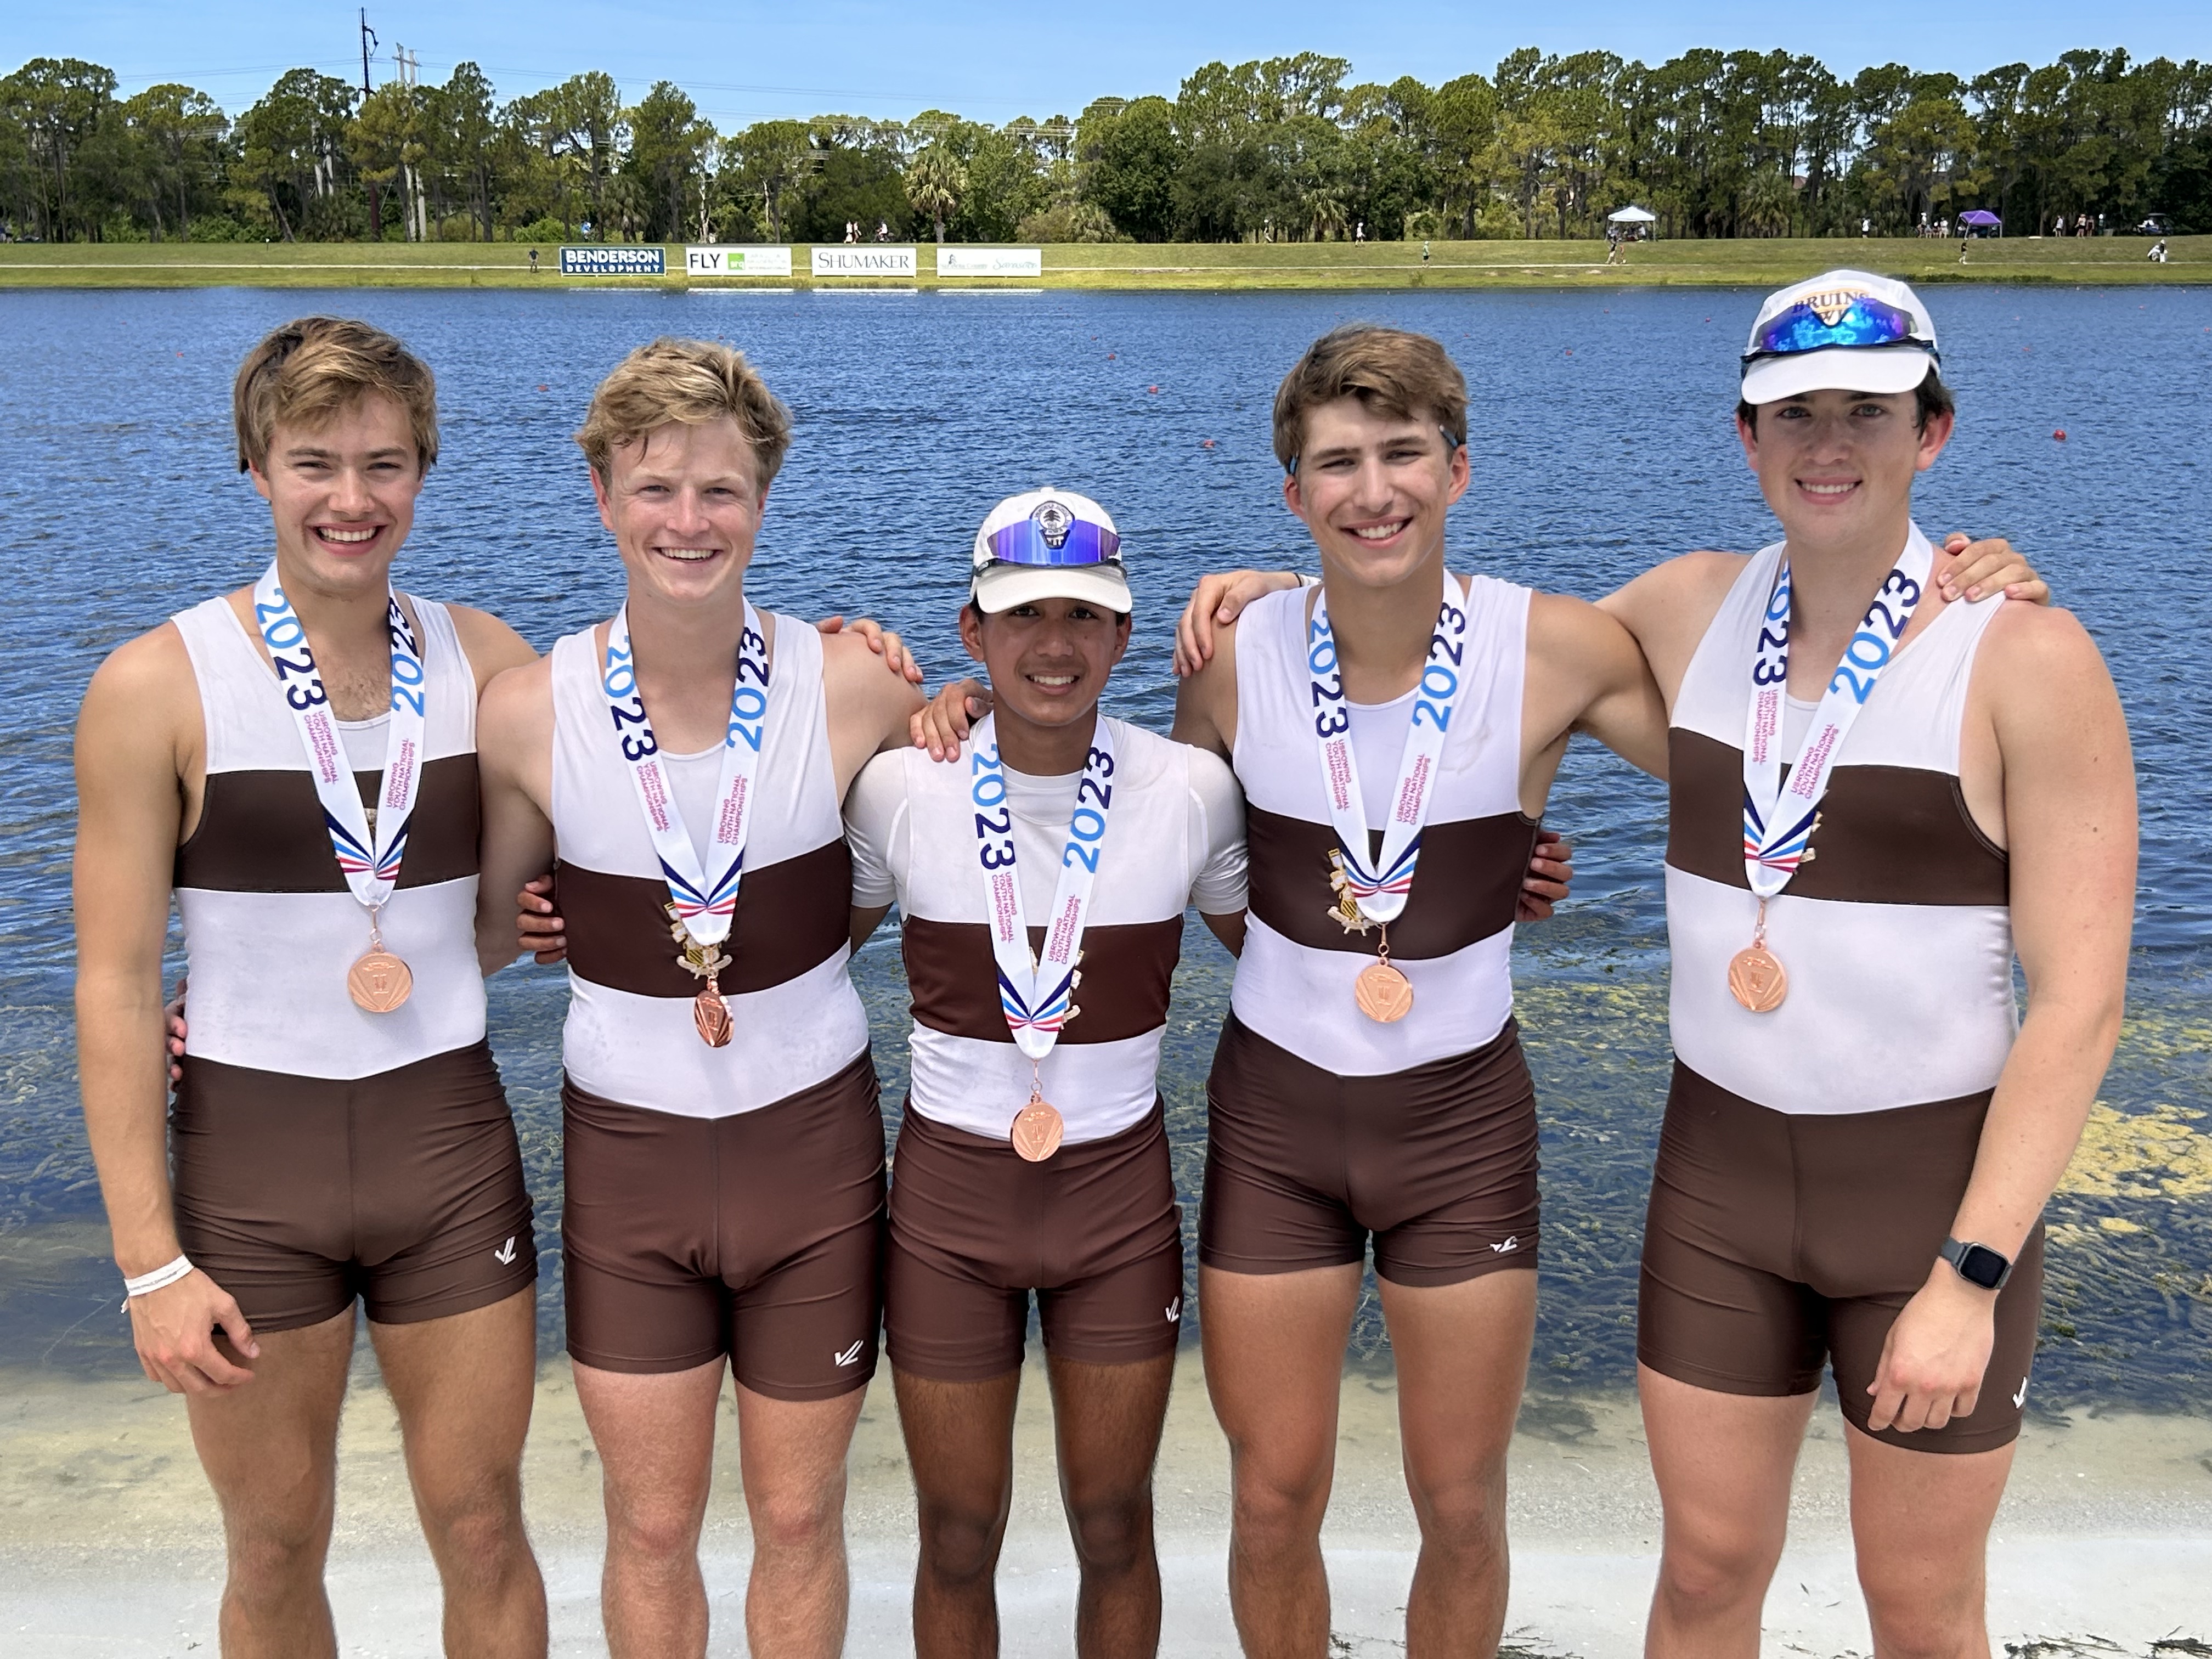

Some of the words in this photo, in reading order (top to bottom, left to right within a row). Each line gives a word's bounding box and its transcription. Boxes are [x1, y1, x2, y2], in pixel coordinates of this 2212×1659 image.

[566, 250, 659, 263] BENDERSON
[690, 253, 721, 269] FLY
[819, 252, 909, 268] SHUMAKER
[256, 588, 328, 710] 2023
[387, 596, 425, 718] 2023
[1753, 565, 1790, 686] 023
[1829, 569, 1920, 704] 2023
[605, 635, 658, 761] 2023
[726, 627, 769, 752] 2023
[1309, 610, 1349, 738] 2023
[1412, 602, 1465, 732] 2023
[1752, 691, 1764, 762] CHAMPIONSHIPS
[1763, 690, 1771, 719] YOUTH
[303, 714, 331, 783] CHAMPIONSHIPS
[311, 712, 325, 741] YOUTH
[321, 742, 340, 785] NATIONAL
[392, 780, 402, 809] YOUTH
[398, 740, 409, 778] NATIONAL
[399, 742, 415, 810] CHAMPIONSHIPS
[1325, 742, 1343, 809] CHAMPIONSHIPS
[1331, 741, 1341, 769] YOUTH
[1337, 770, 1350, 811] NATIONAL
[1759, 721, 1768, 765] NATIONAL
[1797, 765, 1814, 797] YOUTH
[1810, 723, 1835, 765] NATIONAL
[1804, 727, 1839, 800] CHAMPIONSHIPS
[636, 765, 663, 832] CHAMPIONSHIPS
[642, 763, 656, 791] YOUTH
[652, 792, 671, 832] NATIONAL
[724, 816, 733, 844] YOUTH
[730, 775, 741, 814] NATIONAL
[731, 777, 748, 845] CHAMPIONSHIPS
[972, 743, 1016, 870] 2023
[1063, 747, 1114, 873] 2023
[1402, 795, 1414, 823] YOUTH
[1409, 754, 1425, 793] NATIONAL
[1409, 757, 1430, 825] CHAMPIONSHIPS
[991, 874, 1007, 942] CHAMPIONSHIPS
[998, 873, 1008, 901] YOUTH
[1003, 902, 1014, 943] NATIONAL
[1054, 935, 1065, 962] YOUTH
[1061, 895, 1075, 934] NATIONAL
[1060, 898, 1081, 964] CHAMPIONSHIPS
